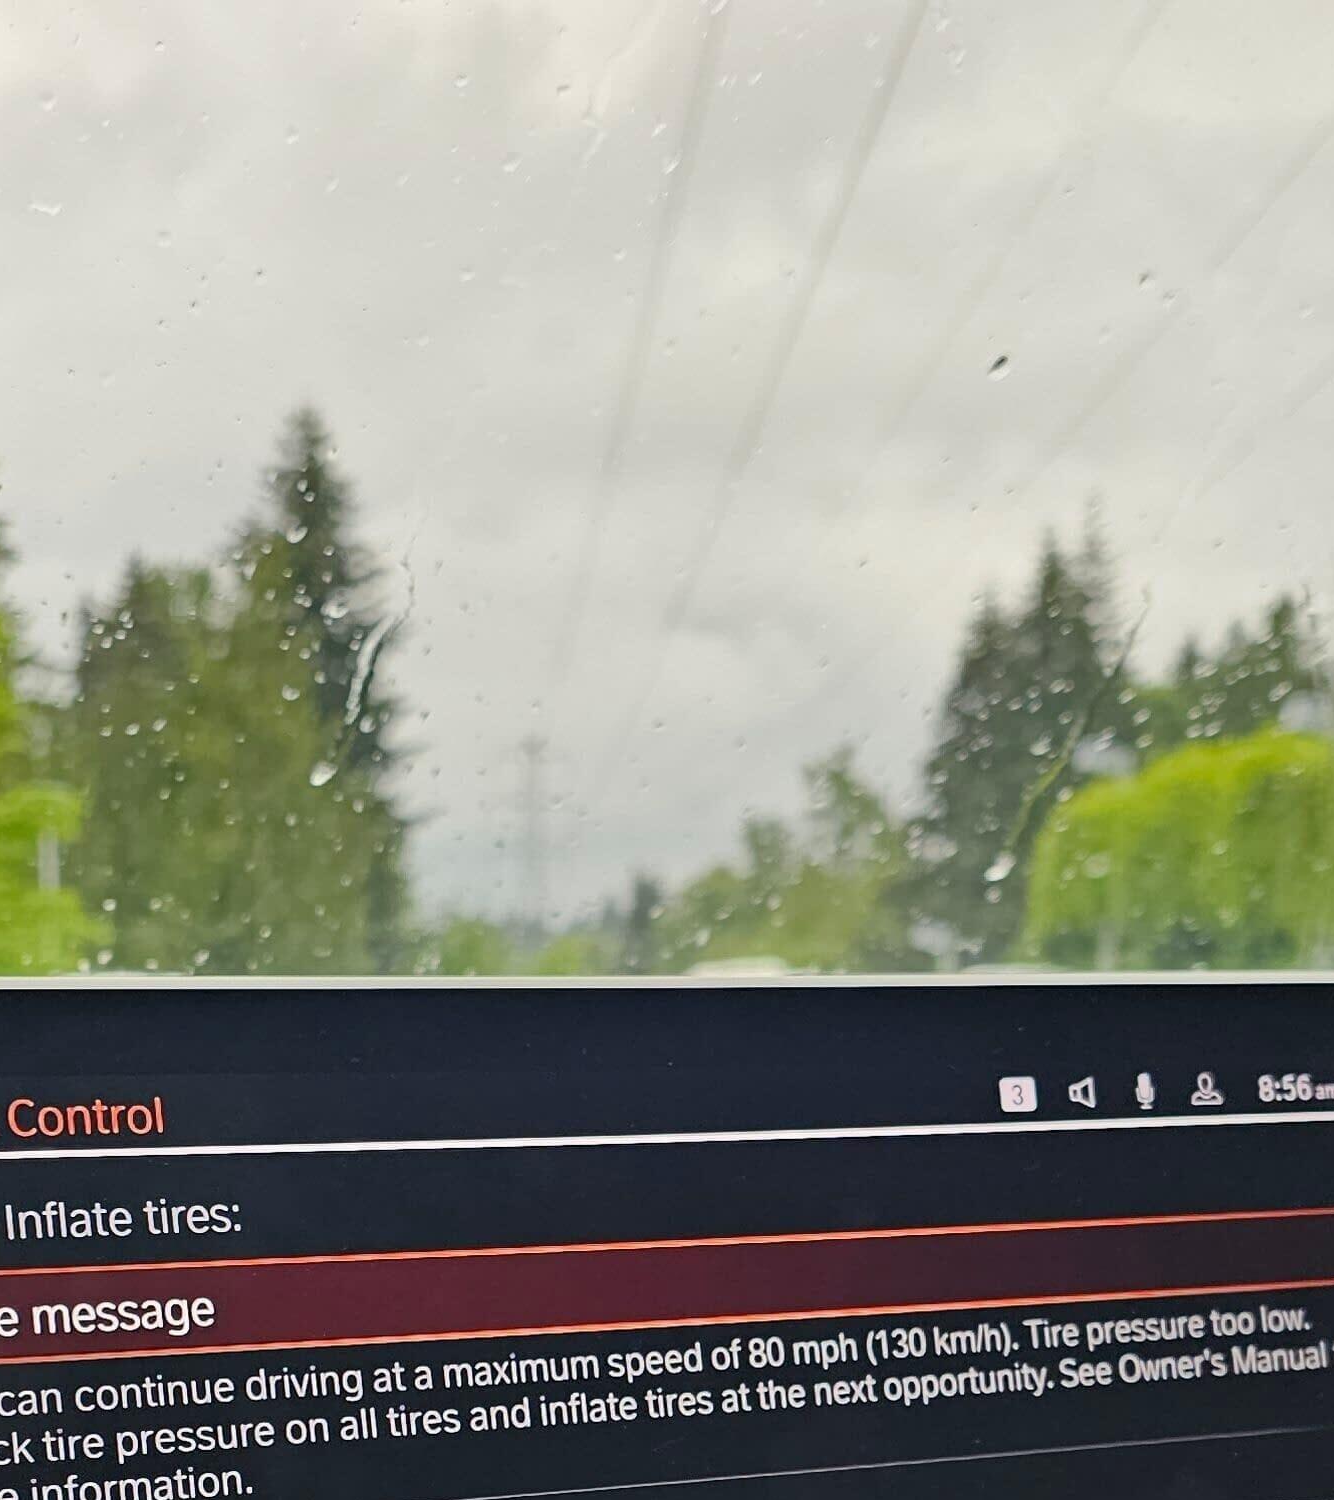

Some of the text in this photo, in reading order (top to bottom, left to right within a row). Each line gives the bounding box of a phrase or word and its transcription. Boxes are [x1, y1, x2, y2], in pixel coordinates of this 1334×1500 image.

[1010, 1084, 1025, 1106] 3
[7, 1096, 164, 1138] Control
[5, 1198, 242, 1241] Inflate tires:
[31, 1297, 215, 1336] message
[75, 1374, 235, 1412] continue
[245, 1365, 364, 1402] driving
[373, 1361, 407, 1393] at
[414, 1365, 434, 1391] a
[442, 1352, 600, 1389] maximum
[607, 1341, 703, 1384] speed
[711, 1337, 742, 1371] of
[748, 1336, 785, 1369] 80
[792, 1332, 859, 1370] mph
[866, 1327, 927, 1366] (130
[932, 1322, 1020, 1357] km/h).
[1022, 1318, 1080, 1349] Tire
[1085, 1314, 1206, 1351] pressure
[1209, 1309, 1255, 1337] too
[1259, 1305, 1311, 1333] low.
[41, 1428, 105, 1462] tire
[116, 1421, 275, 1465] pressure
[285, 1418, 330, 1445] on
[340, 1406, 378, 1441] all
[385, 1404, 461, 1437] tires
[470, 1396, 531, 1432] and
[539, 1392, 638, 1427] inflate
[644, 1387, 714, 1419] tires
[721, 1382, 753, 1414] at
[755, 1379, 806, 1411] the
[813, 1374, 879, 1407] next
[883, 1362, 1055, 1407] opportunity.
[1058, 1357, 1113, 1388] See
[1118, 1347, 1228, 1384] Owner's
[1230, 1340, 1328, 1375] Manual
